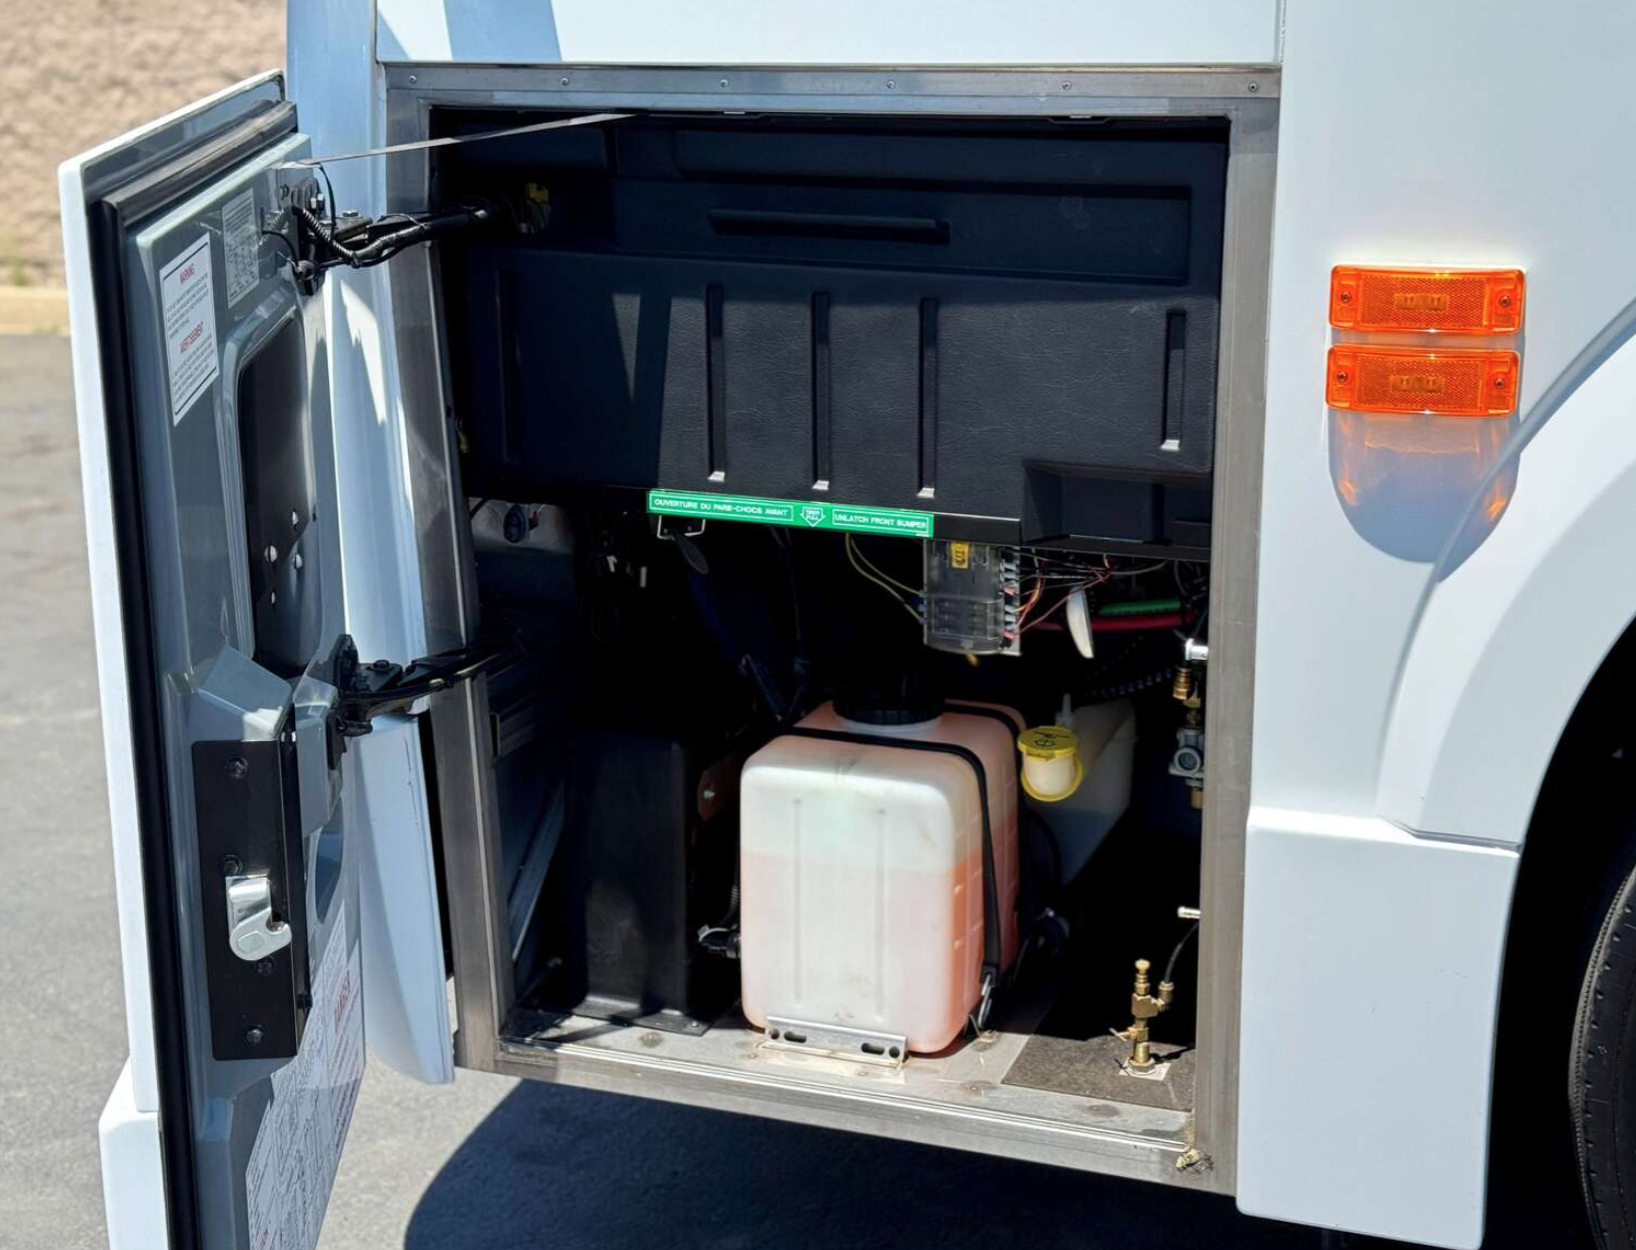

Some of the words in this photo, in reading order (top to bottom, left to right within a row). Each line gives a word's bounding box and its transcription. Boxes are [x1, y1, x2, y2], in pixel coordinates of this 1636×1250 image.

[654, 498, 698, 509] OUVERTURE
[701, 503, 712, 511] DU
[713, 504, 763, 515] PARE-CHOCS
[765, 508, 788, 516] AVANT
[834, 513, 869, 524] UNLATCH
[871, 517, 895, 526] FRONT
[897, 520, 927, 529] BUMPER
